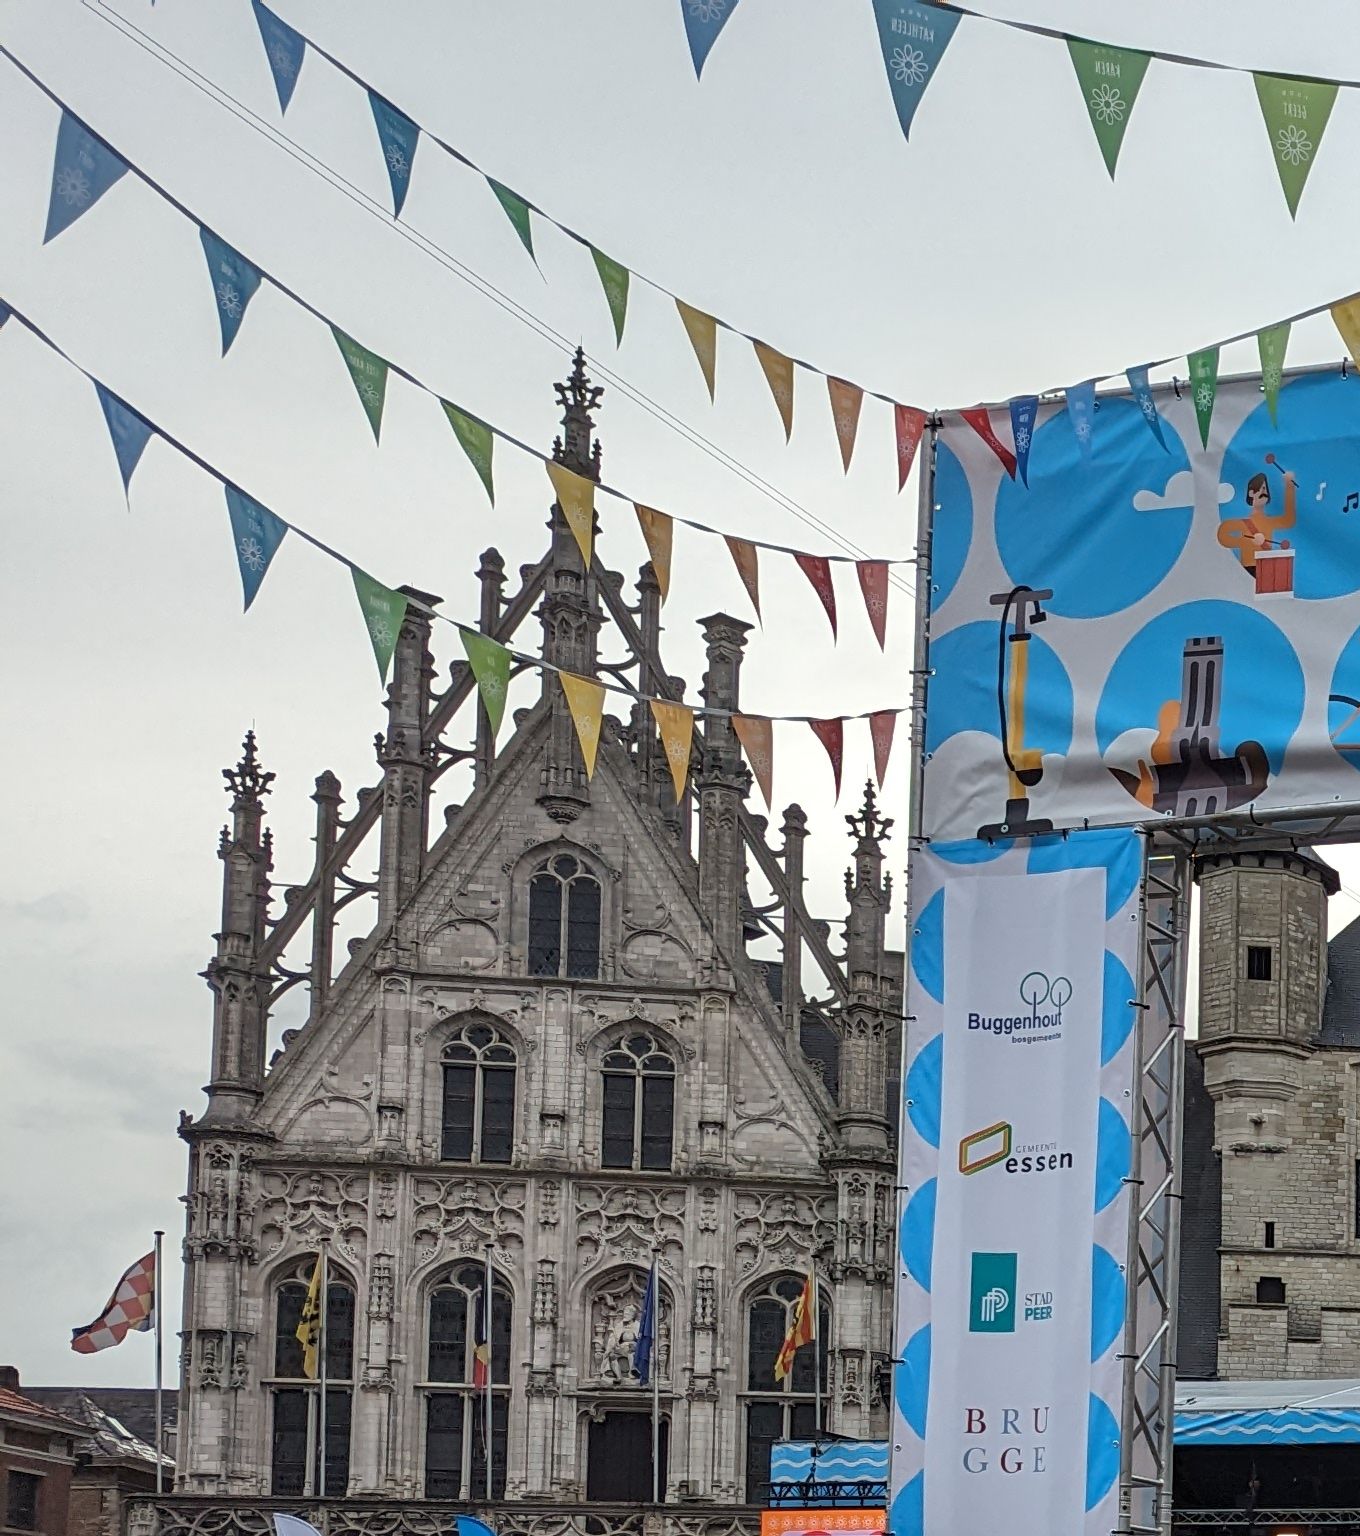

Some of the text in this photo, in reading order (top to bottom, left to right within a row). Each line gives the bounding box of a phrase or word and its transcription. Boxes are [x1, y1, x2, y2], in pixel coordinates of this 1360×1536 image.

[967, 1012, 1063, 1035] Buggenhout
[1010, 1033, 1062, 1045] bosgemeente
[1005, 1152, 1074, 1174] essen
[1025, 1292, 1053, 1307] STAD
[1024, 1306, 1054, 1321] PEER
